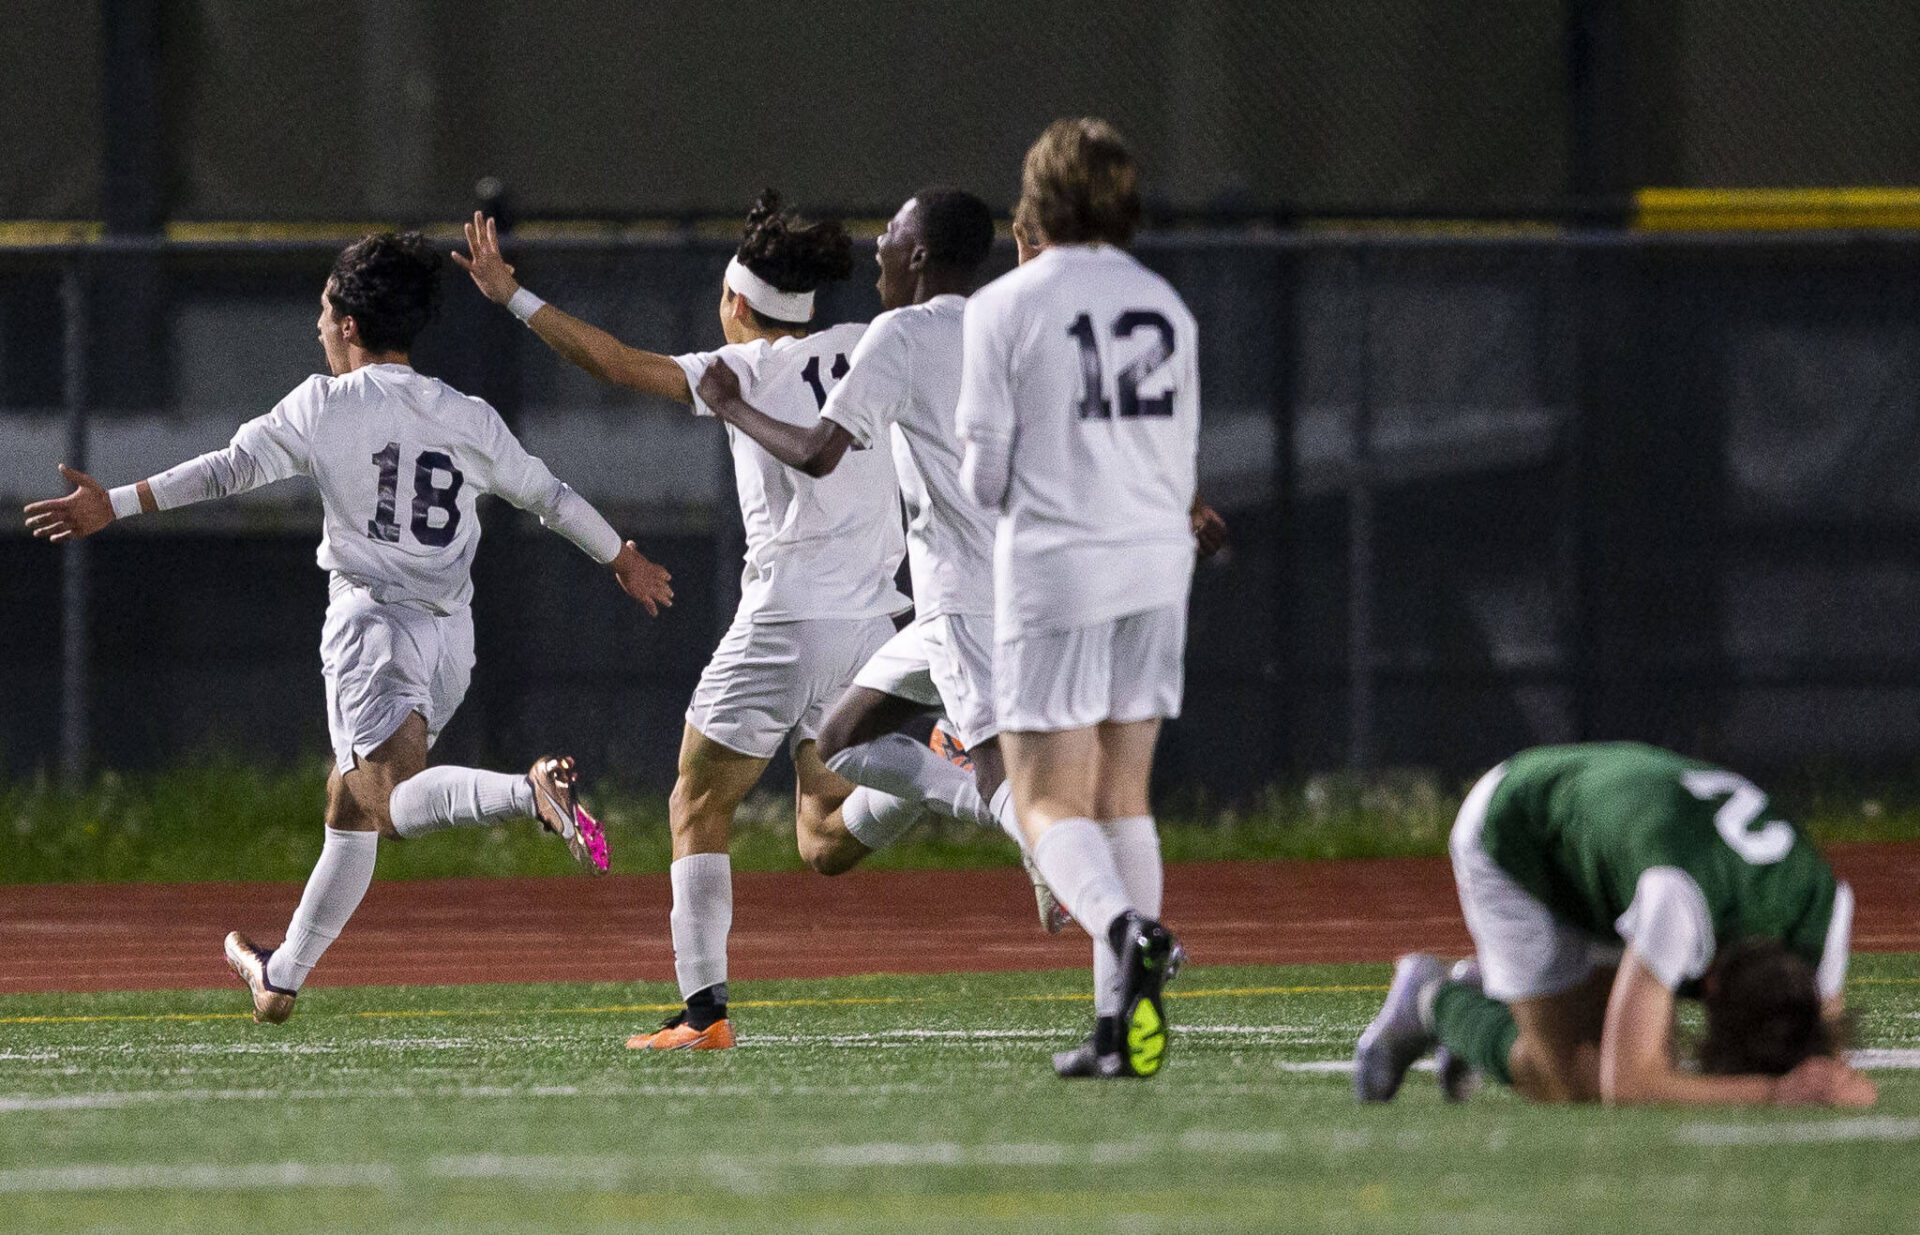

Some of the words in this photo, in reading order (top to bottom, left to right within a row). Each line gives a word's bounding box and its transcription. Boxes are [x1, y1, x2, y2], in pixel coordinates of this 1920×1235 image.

[1067, 311, 1176, 419] 12
[367, 441, 464, 548] 18
[1680, 769, 1796, 865] 2
